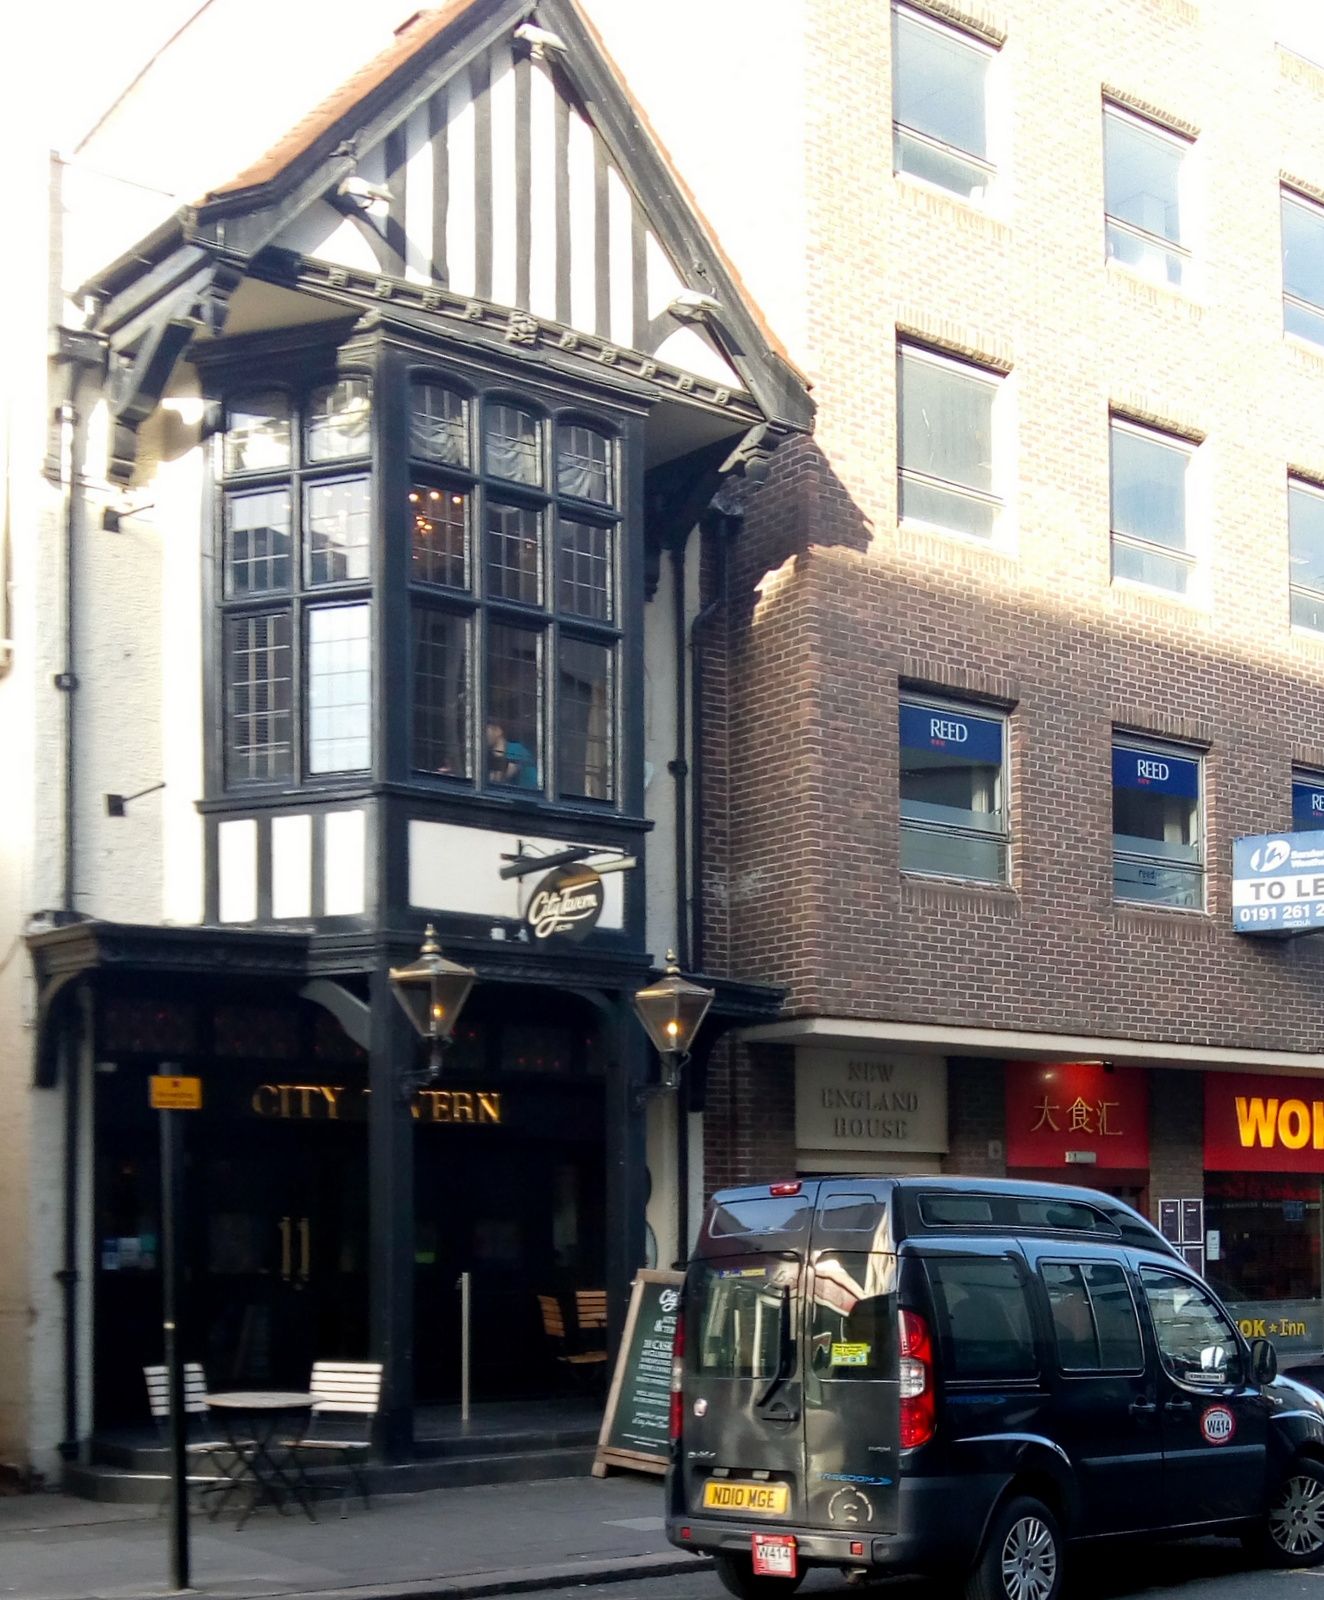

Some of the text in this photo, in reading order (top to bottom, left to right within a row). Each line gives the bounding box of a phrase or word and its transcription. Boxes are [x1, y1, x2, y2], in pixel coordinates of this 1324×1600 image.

[930, 718, 968, 743] REED
[1137, 759, 1169, 781] REED
[1311, 793, 1324, 812] RE
[1249, 877, 1324, 901] TO LE
[1240, 906, 1278, 923] 0191
[1282, 903, 1311, 920] 261
[847, 1061, 894, 1083] NEW
[252, 1085, 346, 1119] CITY
[821, 1087, 920, 1113] ENGLAND
[1030, 1095, 1124, 1136] 大食汇
[834, 1117, 907, 1140] HOUSE
[1236, 1318, 1306, 1338] OK Inn
[1206, 1420, 1230, 1434] W414
[713, 1485, 775, 1509] ND10 MGE
[758, 1546, 791, 1560] W414
